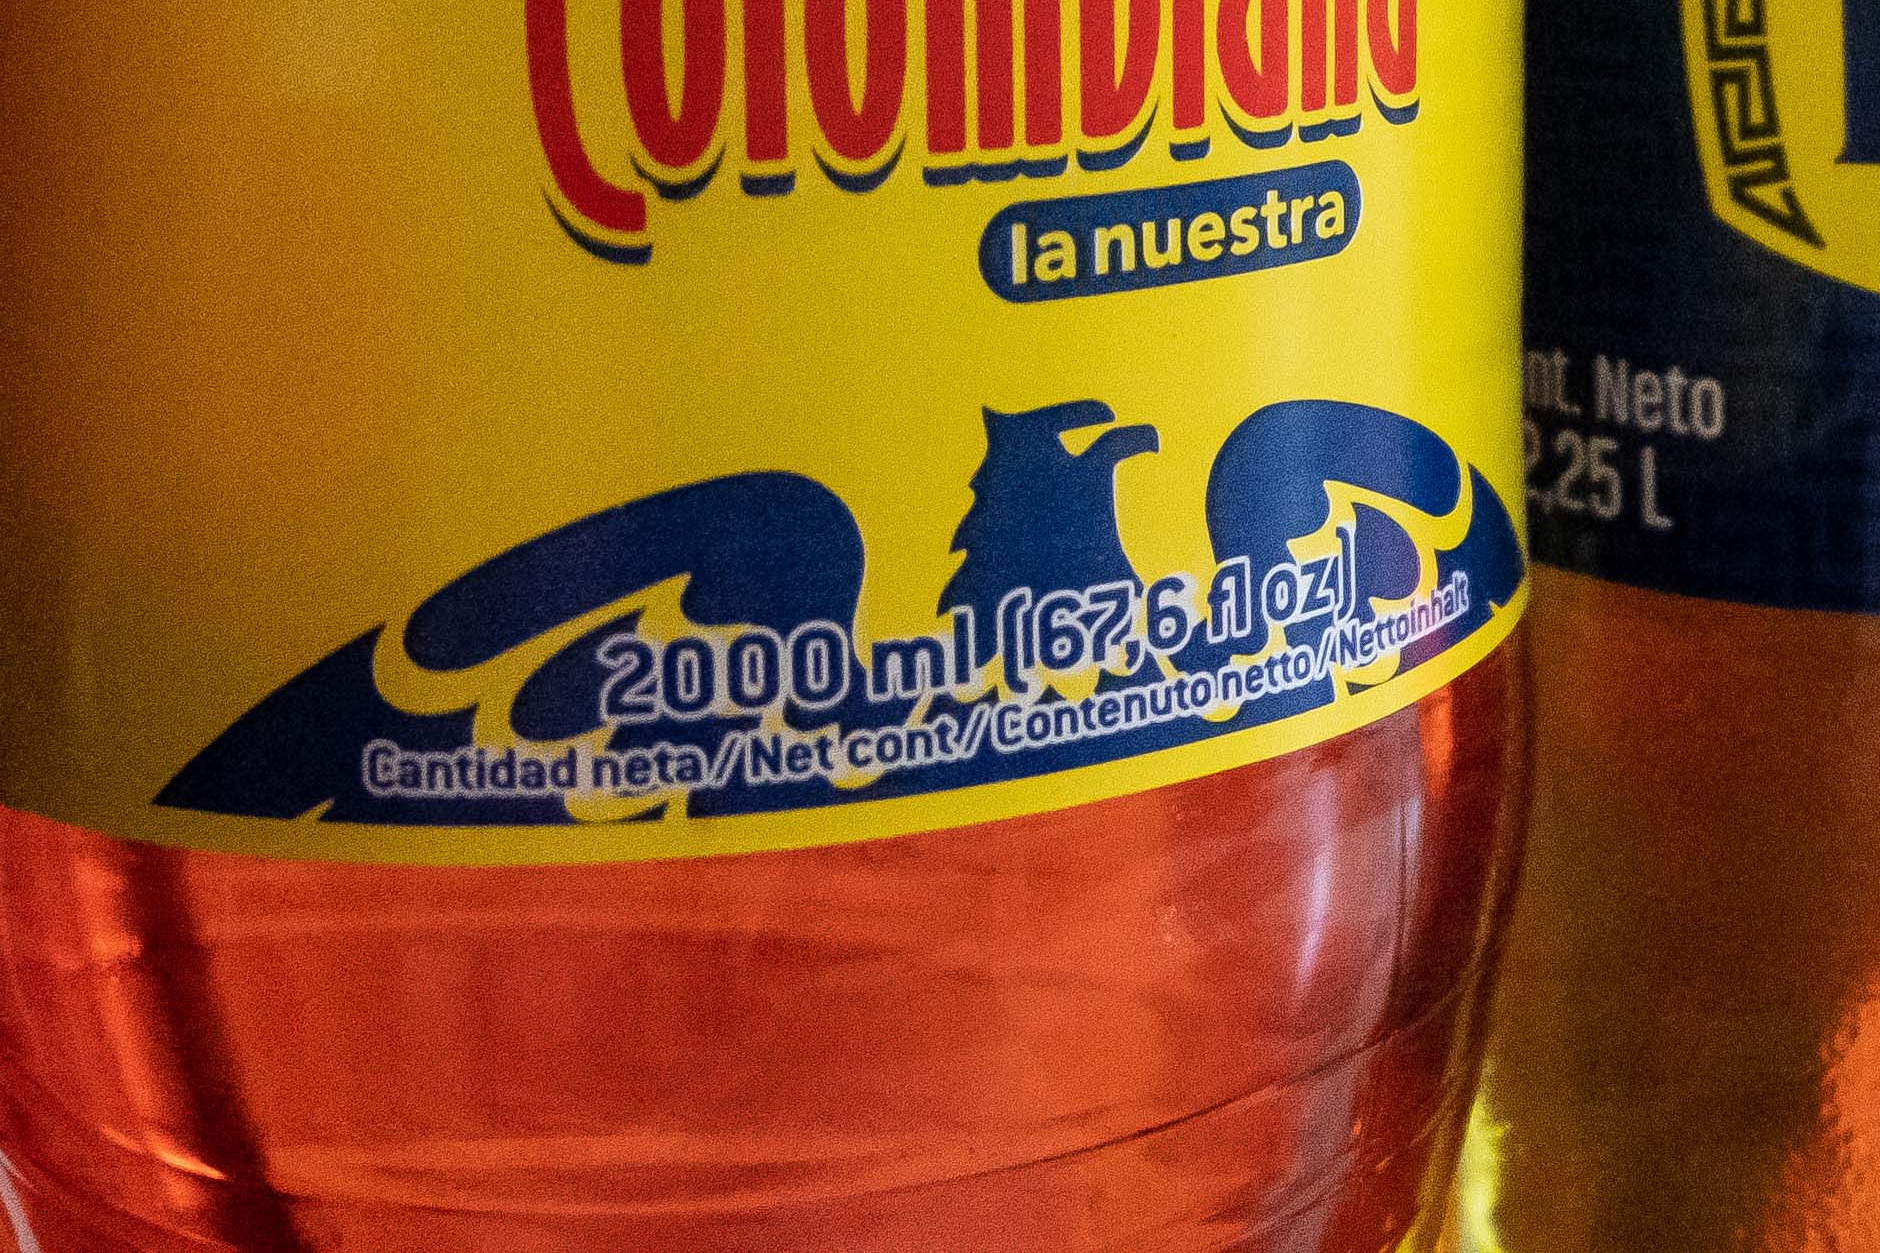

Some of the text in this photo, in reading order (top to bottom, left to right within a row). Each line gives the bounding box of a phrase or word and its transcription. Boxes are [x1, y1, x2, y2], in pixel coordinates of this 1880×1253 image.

[1009, 189, 1348, 283] la nuestra
[1592, 353, 1727, 441] Neto
[1639, 444, 1674, 530] L
[599, 622, 850, 722] 2000
[867, 602, 976, 701] ml
[1206, 558, 1252, 642] fl
[365, 739, 577, 798] Cantidad
